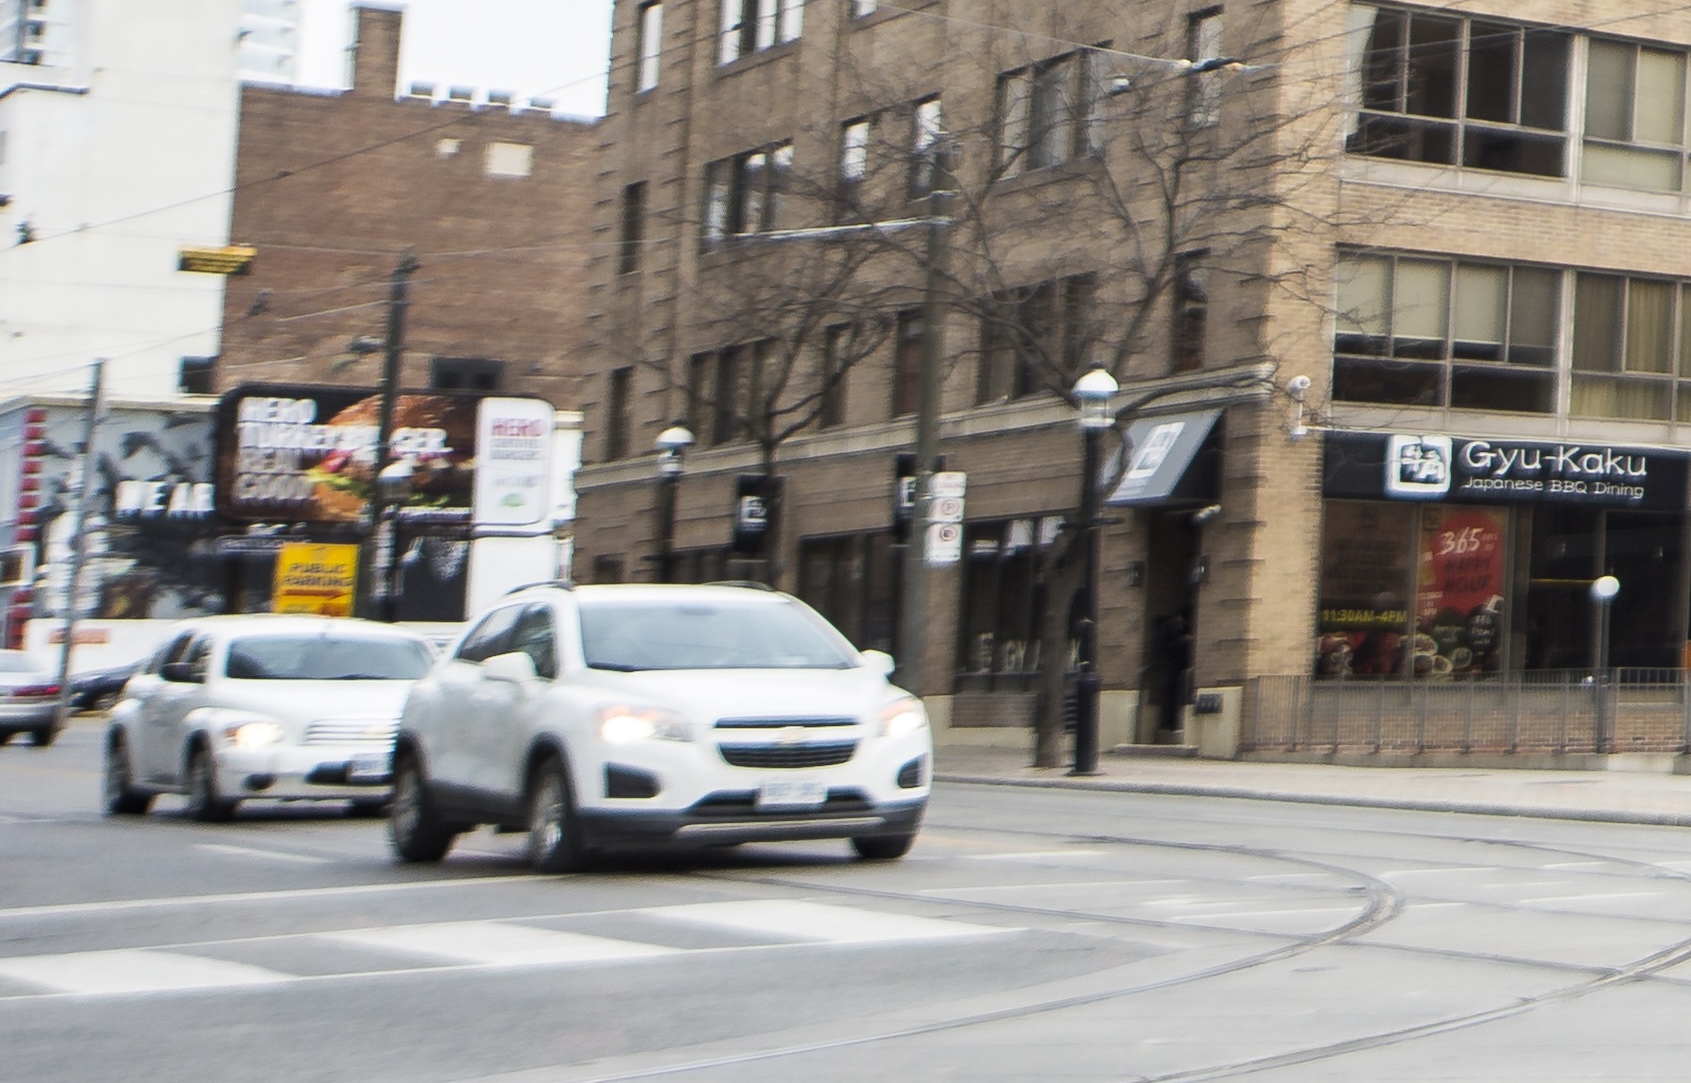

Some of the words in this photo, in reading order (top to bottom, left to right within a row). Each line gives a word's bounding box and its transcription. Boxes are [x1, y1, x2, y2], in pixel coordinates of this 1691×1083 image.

[1465, 441, 1648, 478] Gyu-Kaku
[1461, 476, 1543, 494] Japanese
[1551, 479, 1588, 494] BBQ
[1594, 480, 1645, 500] Dining
[1437, 527, 1484, 556] 365
